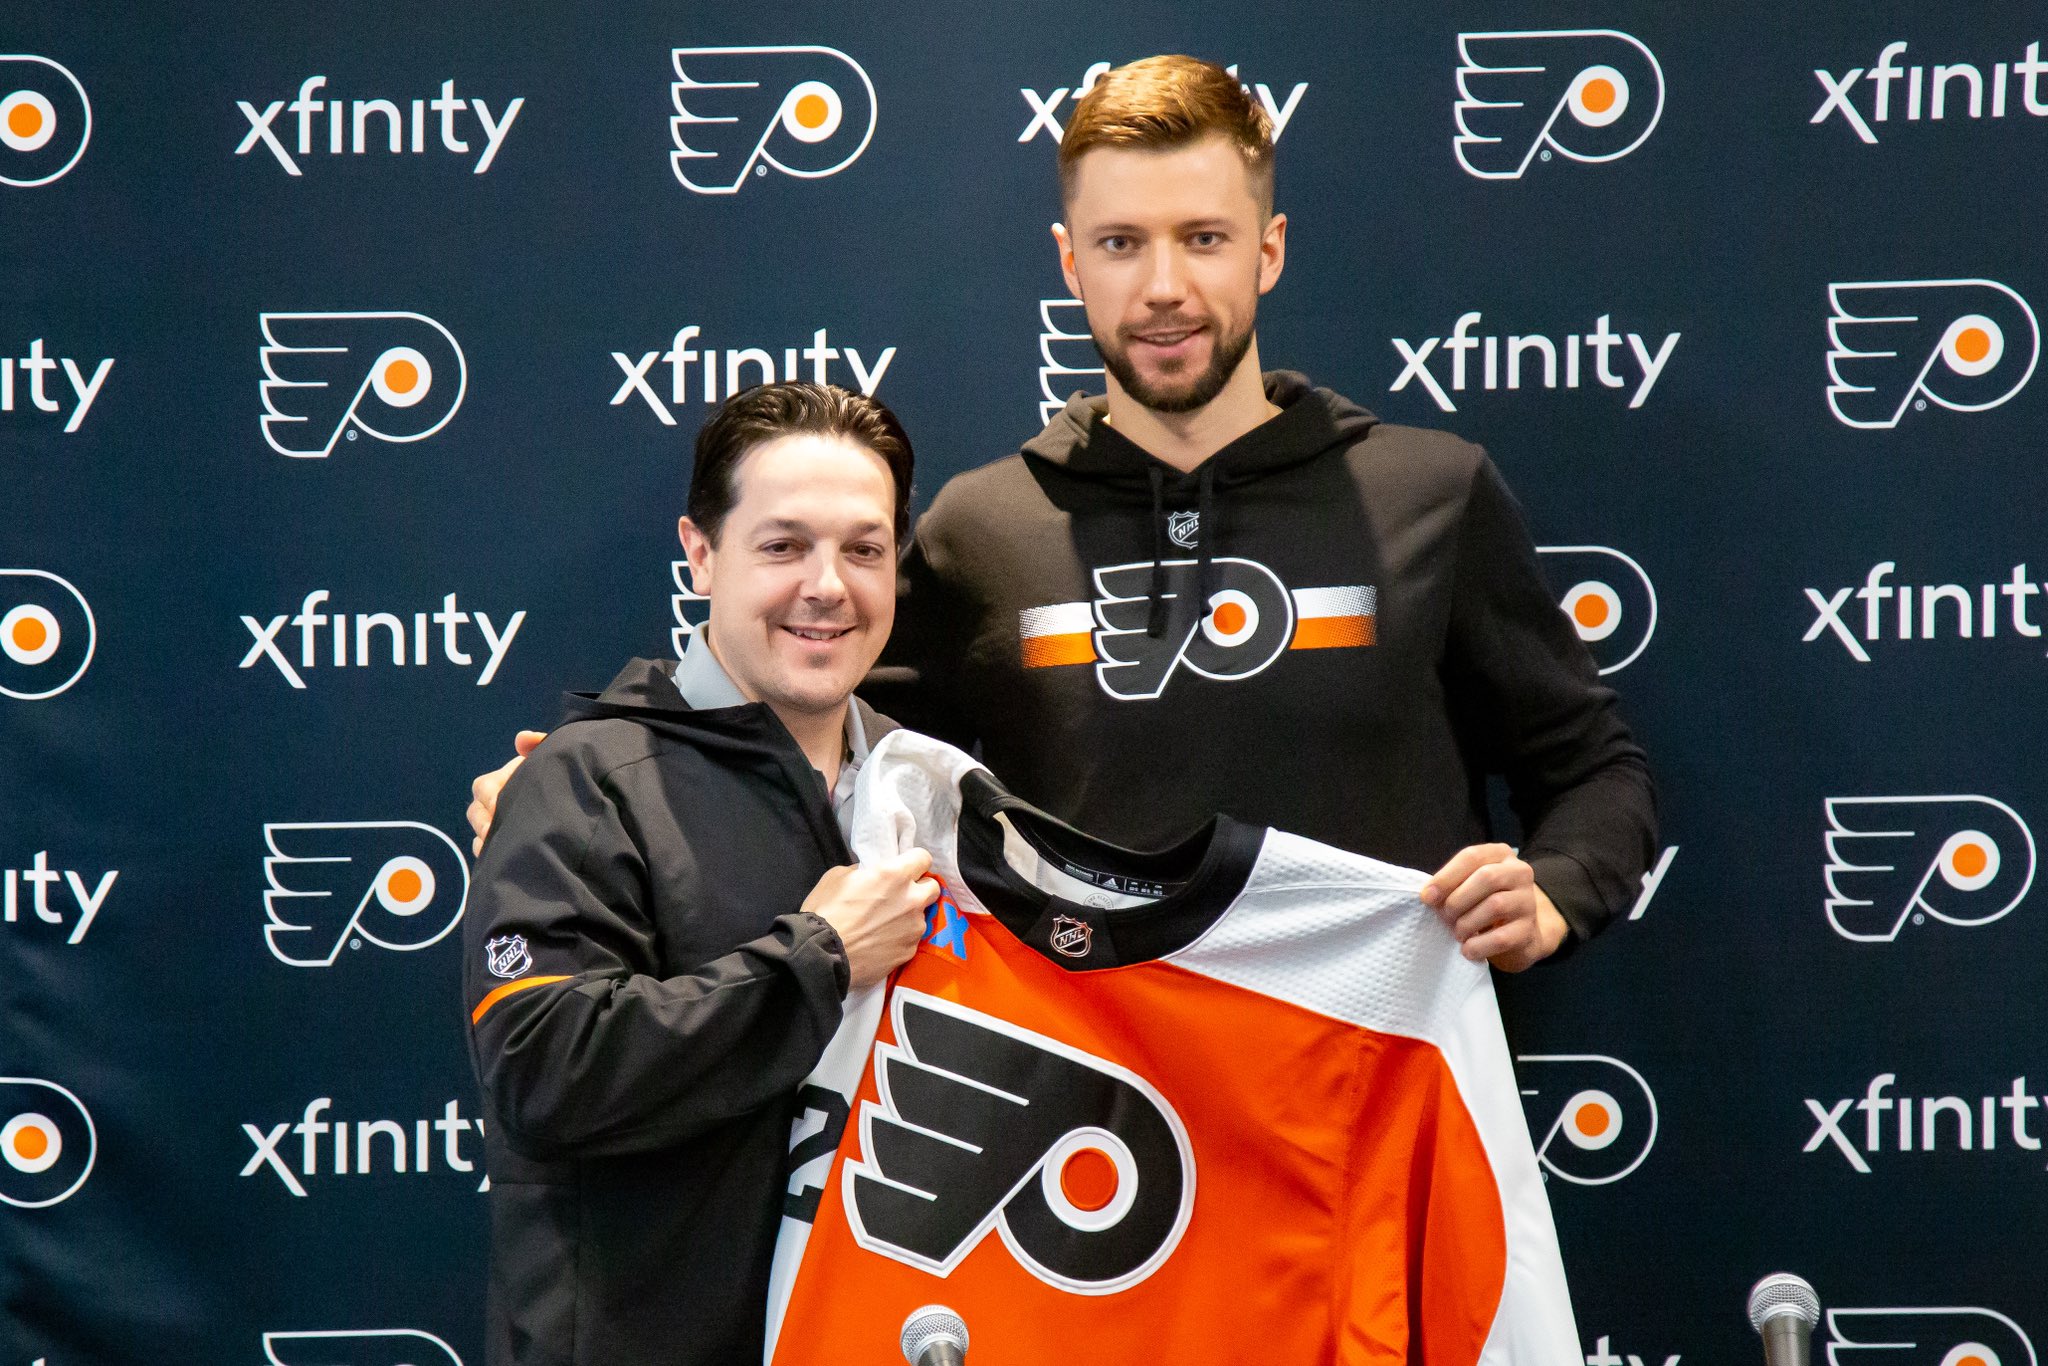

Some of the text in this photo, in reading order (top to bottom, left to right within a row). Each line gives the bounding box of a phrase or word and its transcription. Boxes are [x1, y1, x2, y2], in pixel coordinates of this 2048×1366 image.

[235, 76, 525, 177] xfinity
[1390, 312, 1682, 414] xfinity
[239, 590, 527, 689] xfinity
[1802, 561, 2048, 662] xfinit
[498, 946, 521, 970] NHL
[1060, 930, 1085, 946] NHL
[240, 1098, 491, 1197] xfinit
[1802, 1073, 2048, 1173] xfinit
